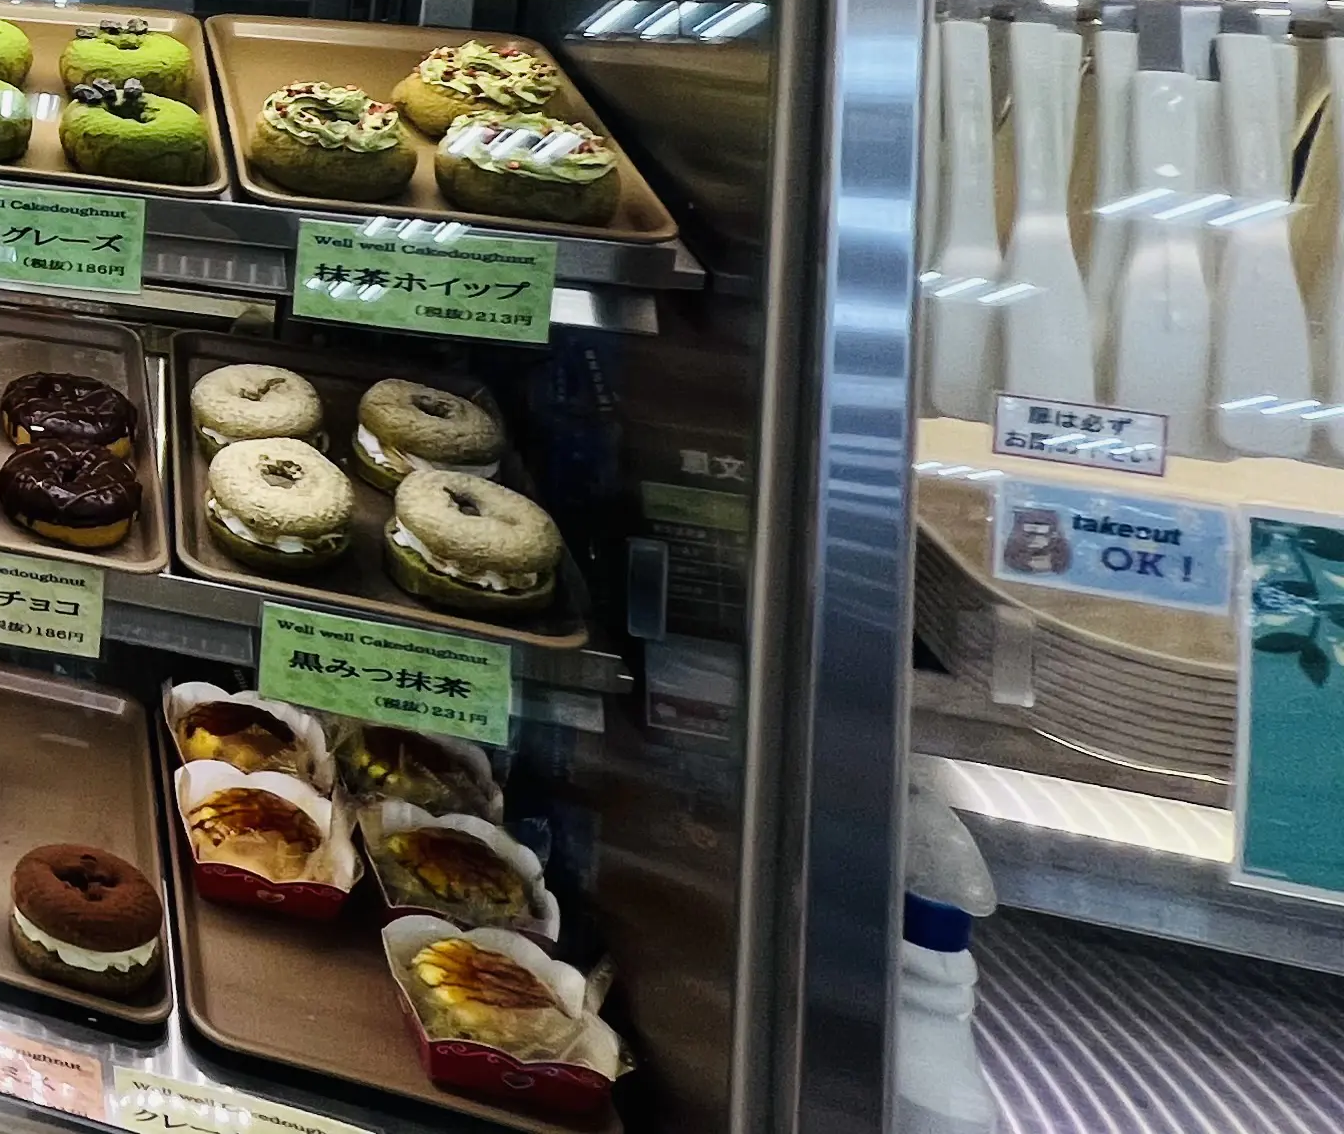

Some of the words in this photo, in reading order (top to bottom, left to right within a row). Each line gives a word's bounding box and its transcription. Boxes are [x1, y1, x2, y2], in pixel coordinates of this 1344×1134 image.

[11, 200, 126, 218] Cakedoughnut
[314, 235, 353, 249] Well
[360, 242, 395, 253] well
[402, 245, 535, 266] Cakedoughnut
[23, 257, 124, 276] (税抜)186円
[314, 263, 531, 301] 抹茶ホイップ
[415, 305, 532, 326] (税抜)213円
[1072, 514, 1182, 546] takeout
[1102, 547, 1166, 578] OK
[277, 619, 314, 635] Well
[320, 629, 354, 642] well
[360, 635, 488, 665] Cakedoughnut
[288, 649, 471, 699] 黒みつ抹茶
[375, 696, 488, 726] (税抜)231円
